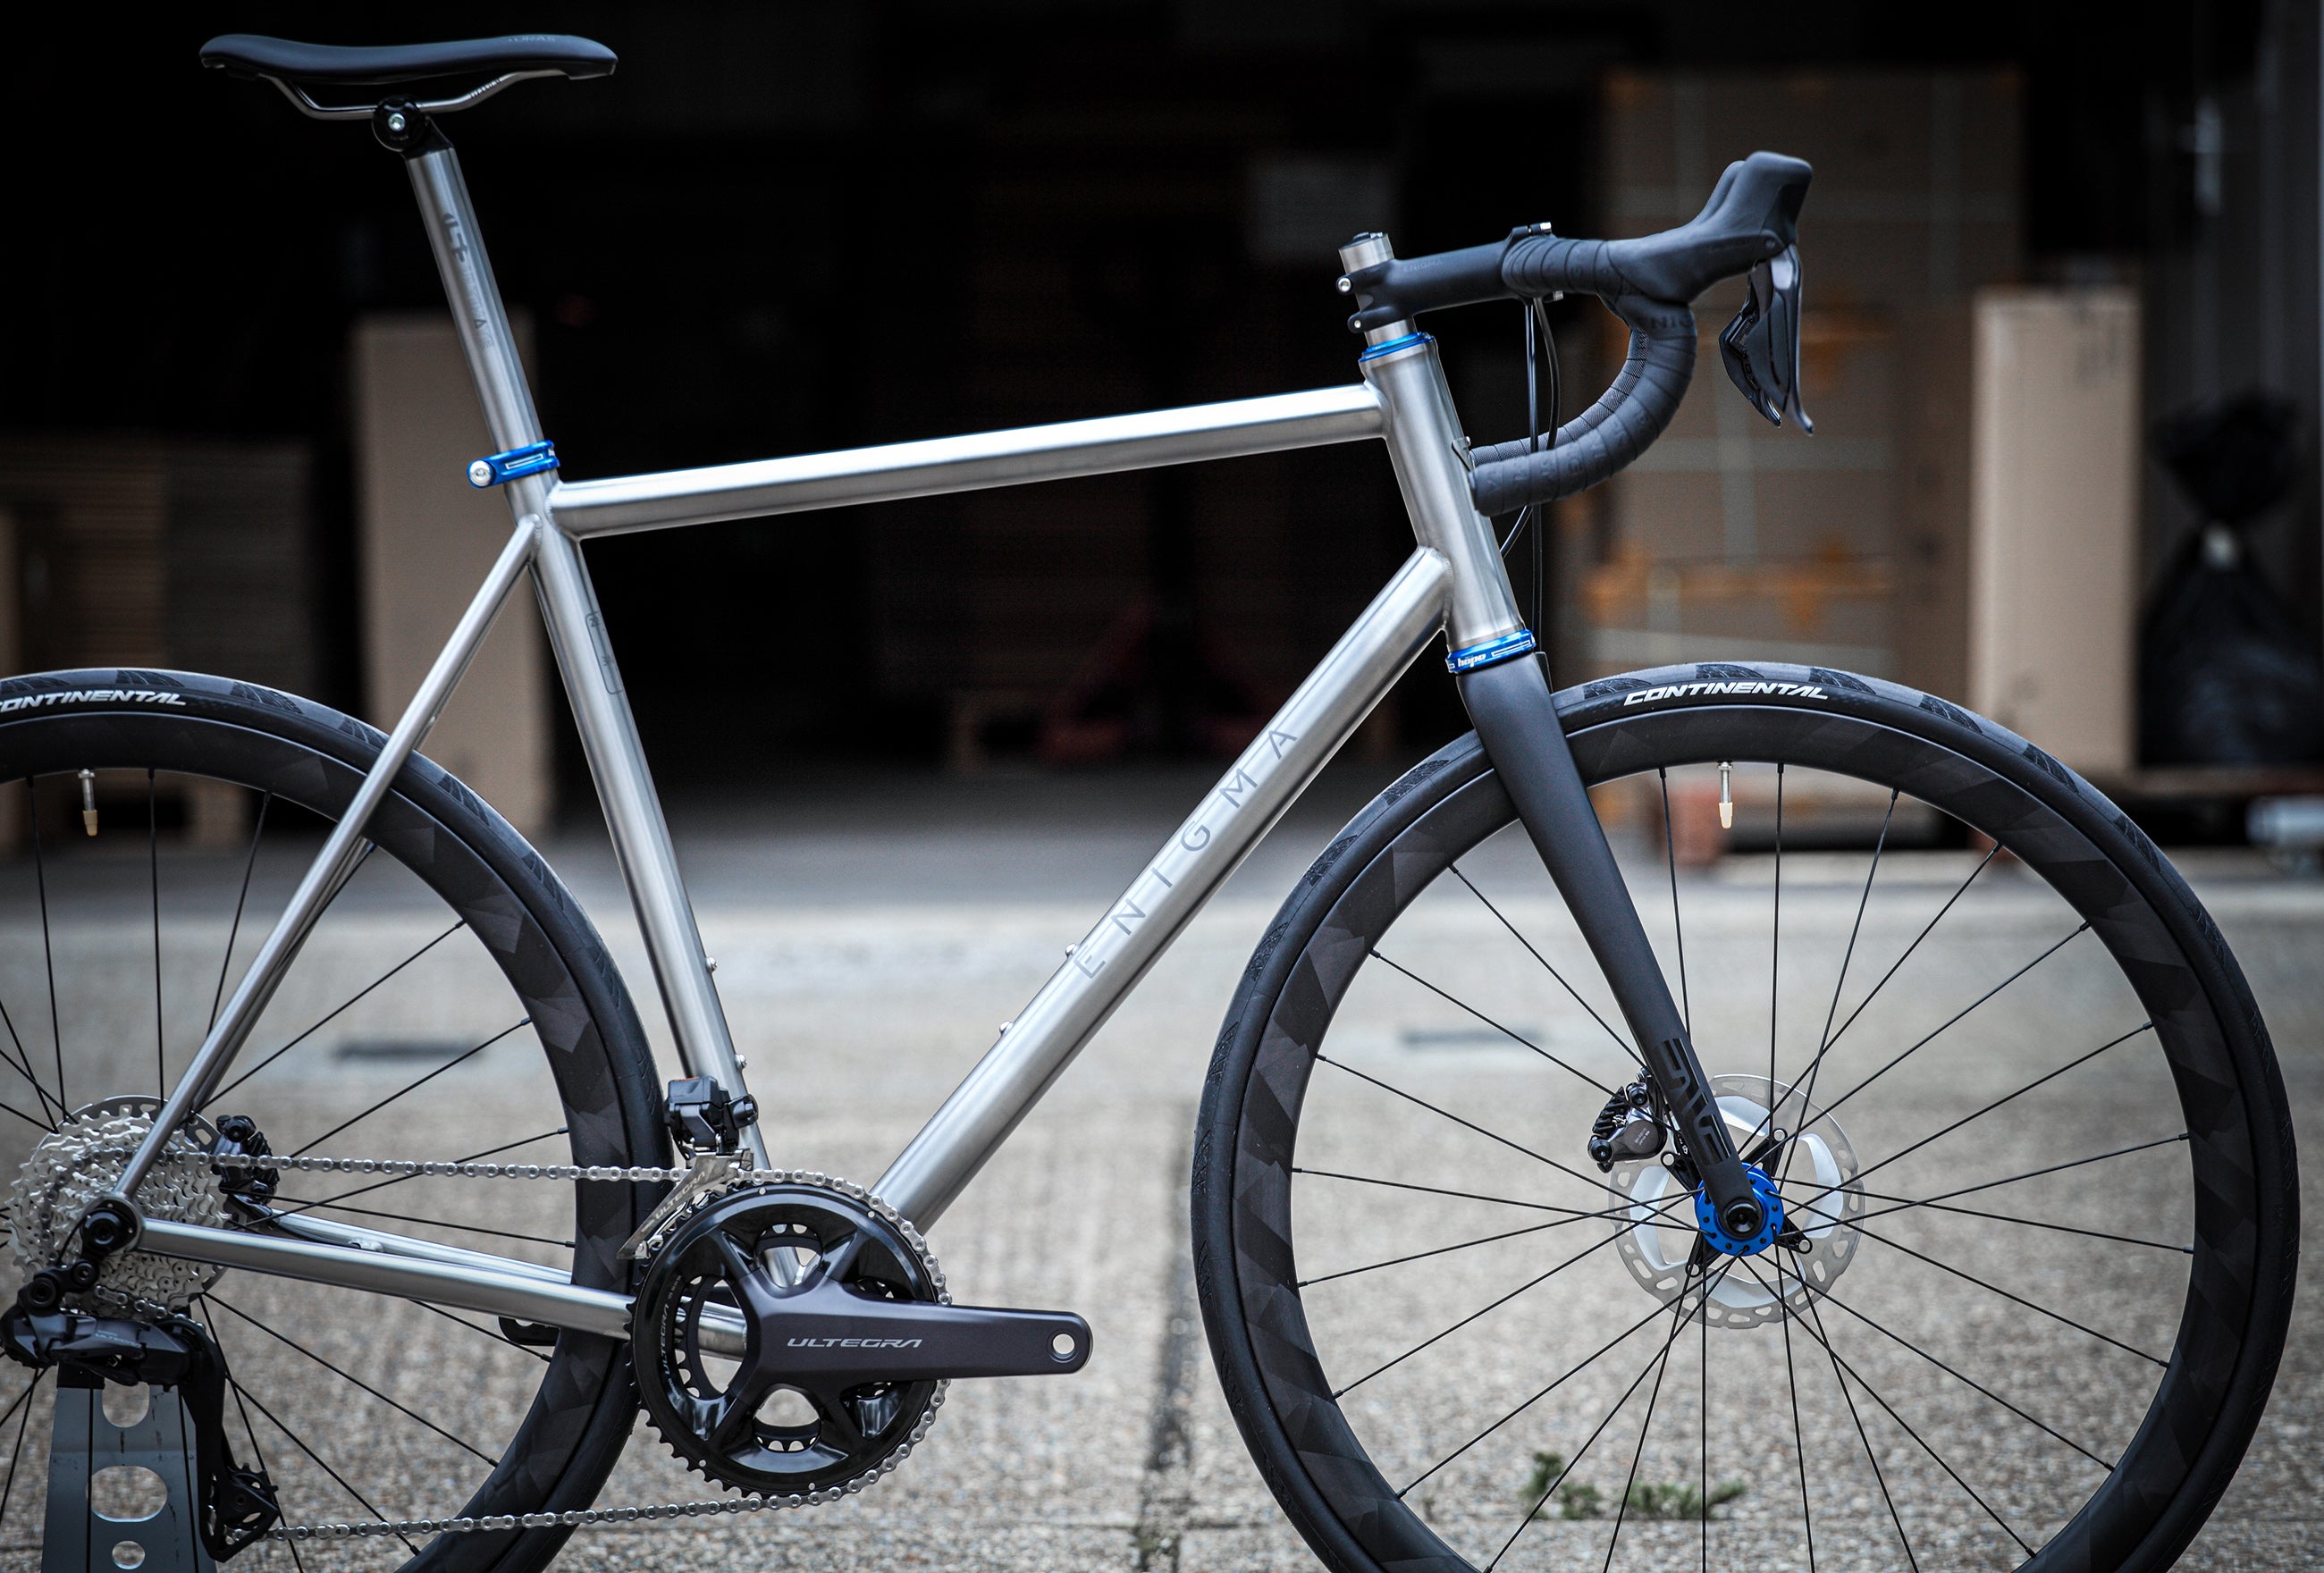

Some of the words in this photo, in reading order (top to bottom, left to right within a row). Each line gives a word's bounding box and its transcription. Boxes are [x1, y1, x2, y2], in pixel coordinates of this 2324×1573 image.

[1457, 653, 1486, 668] hope
[0, 689, 187, 713] ONTINENTAL
[1622, 681, 1829, 707] CONTINENTAL
[1074, 728, 1298, 980] ENIGMA
[655, 1172, 705, 1219] ULTEGRA
[660, 1303, 669, 1375] ULTEGRA
[787, 1338, 923, 1349] ULTEGRA
